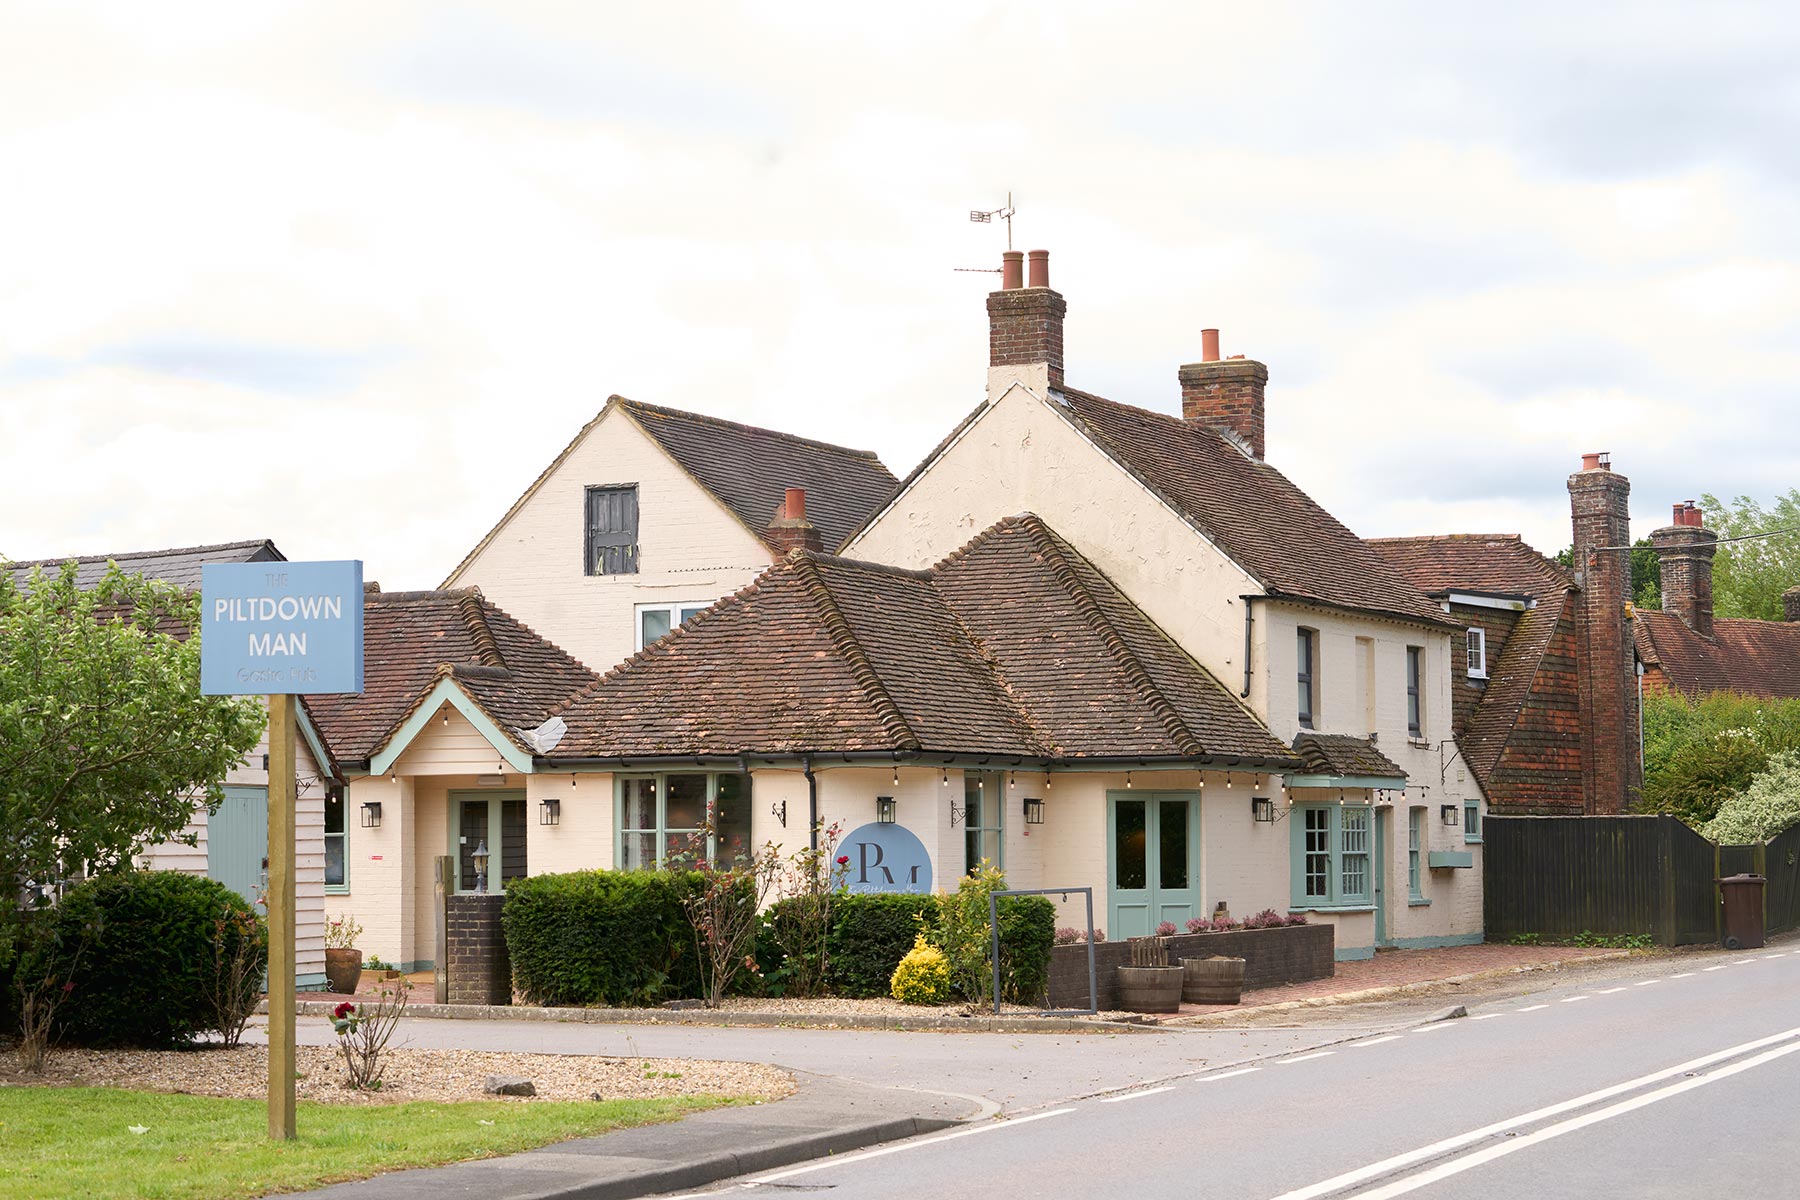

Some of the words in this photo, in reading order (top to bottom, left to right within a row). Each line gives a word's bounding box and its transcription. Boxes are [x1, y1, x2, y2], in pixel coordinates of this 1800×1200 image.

[265, 573, 289, 587] THE
[214, 596, 342, 622] PILTDOWN
[249, 632, 307, 657] MAN
[237, 667, 285, 683] Gastro
[289, 667, 318, 682] Pub
